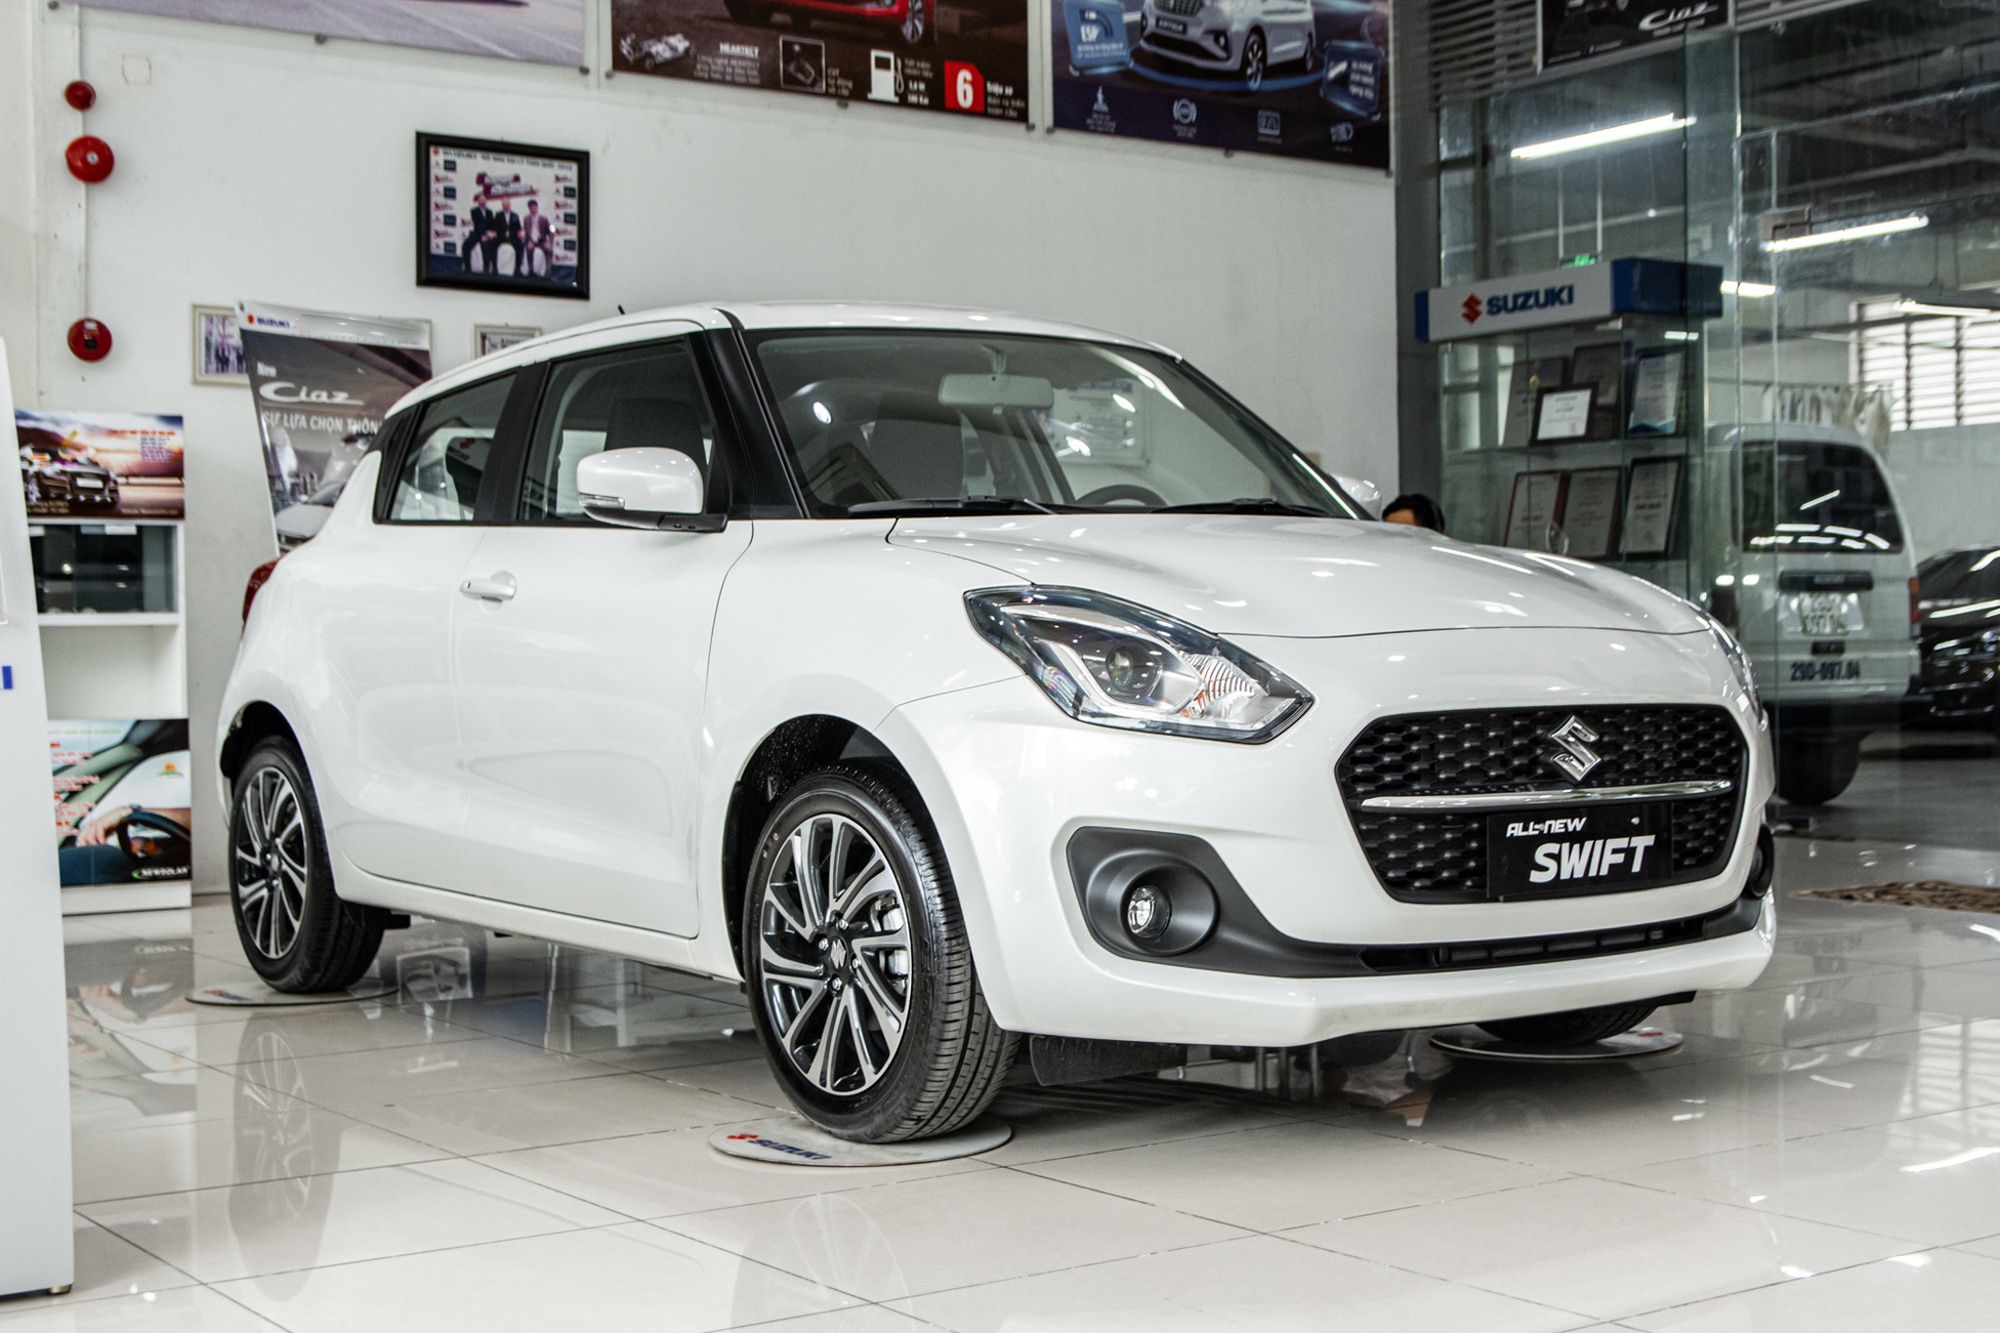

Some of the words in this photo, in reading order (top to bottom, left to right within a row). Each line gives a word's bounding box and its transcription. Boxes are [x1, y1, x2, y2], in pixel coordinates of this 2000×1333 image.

[1638, 2, 1719, 31] Ciaz
[956, 69, 974, 109] 6
[1487, 283, 1575, 316] SUZUKI
[256, 361, 277, 378] New
[259, 380, 365, 406] Ciaz
[283, 411, 308, 431] LỰA
[310, 415, 344, 434] CHỌN
[1529, 834, 1656, 883] SWIFT
